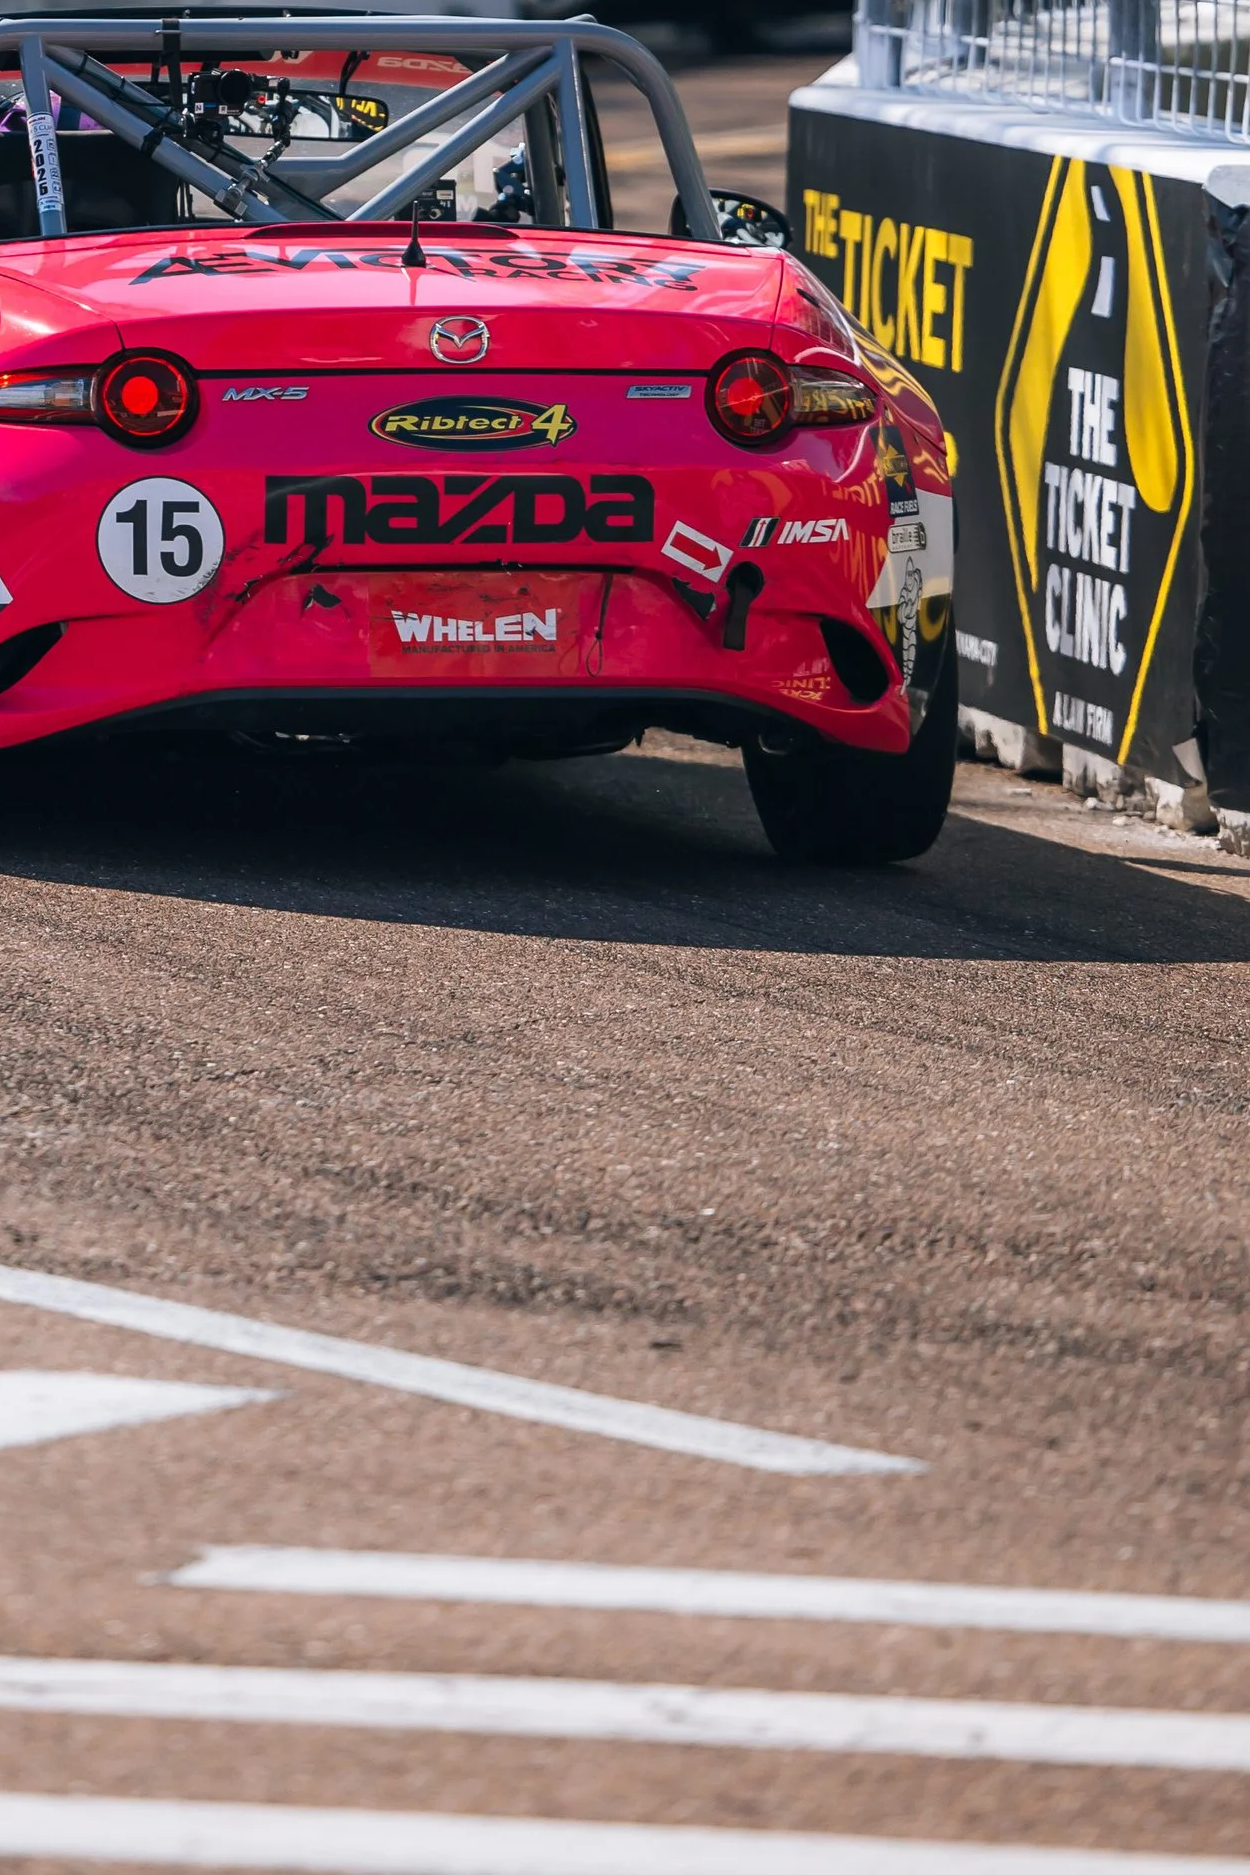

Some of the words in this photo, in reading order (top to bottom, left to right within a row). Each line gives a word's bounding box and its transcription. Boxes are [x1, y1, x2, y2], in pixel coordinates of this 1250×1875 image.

[803, 188, 840, 259] THE
[458, 267, 698, 291] RACING
[839, 209, 974, 373] TICKET
[222, 387, 309, 401] MX-5
[1068, 366, 1119, 467] THE
[531, 403, 571, 447] 4
[115, 500, 204, 577] 15
[777, 518, 849, 545] IMSA
[1045, 461, 1136, 573] TICKET
[391, 608, 557, 642] WHELEN
[1045, 563, 1127, 676] CLINIC
[402, 645, 490, 653] MANUFACTURED
[508, 645, 557, 653] AMERICA
